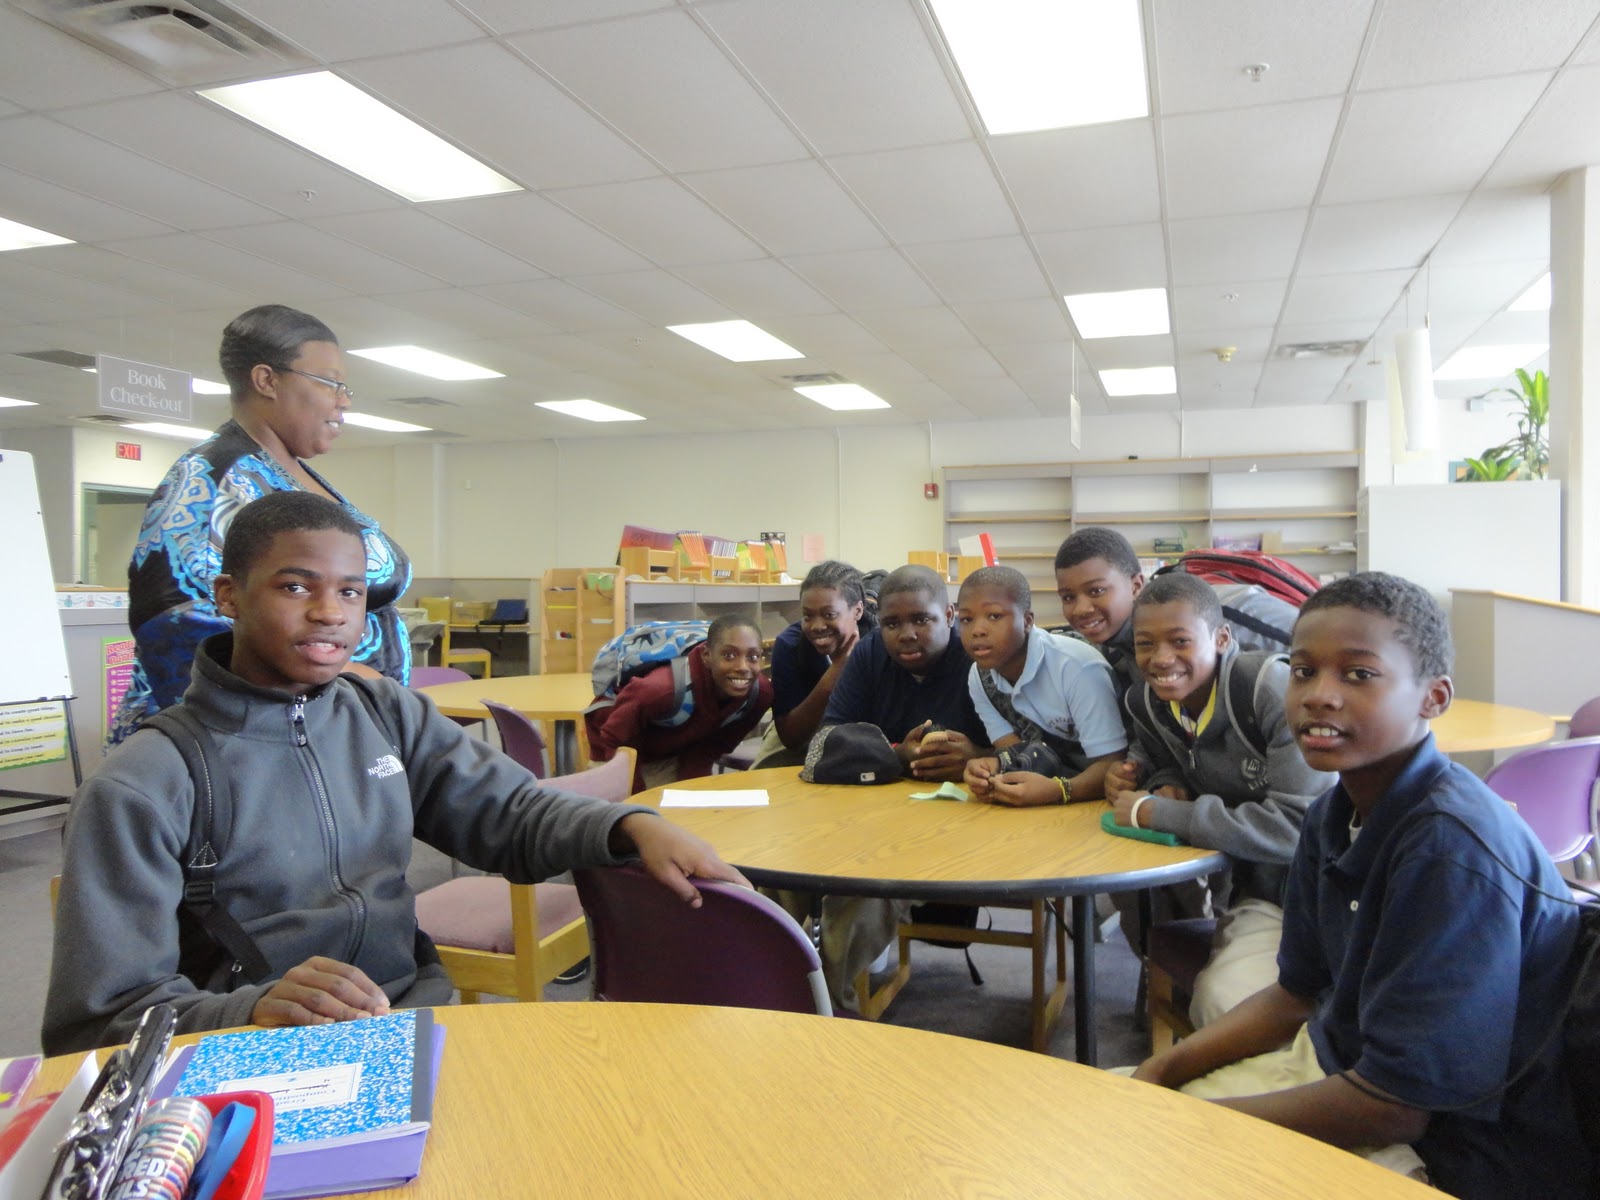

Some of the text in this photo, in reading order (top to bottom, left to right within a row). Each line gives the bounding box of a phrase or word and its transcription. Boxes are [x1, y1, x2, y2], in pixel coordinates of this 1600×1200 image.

[128, 369, 167, 390] Book
[110, 386, 183, 412] Check-out
[118, 443, 140, 460] EXIT
[376, 755, 390, 765] THE
[368, 763, 392, 776] NORTH
[377, 767, 396, 779] FACE
[119, 1158, 165, 1181] RED
